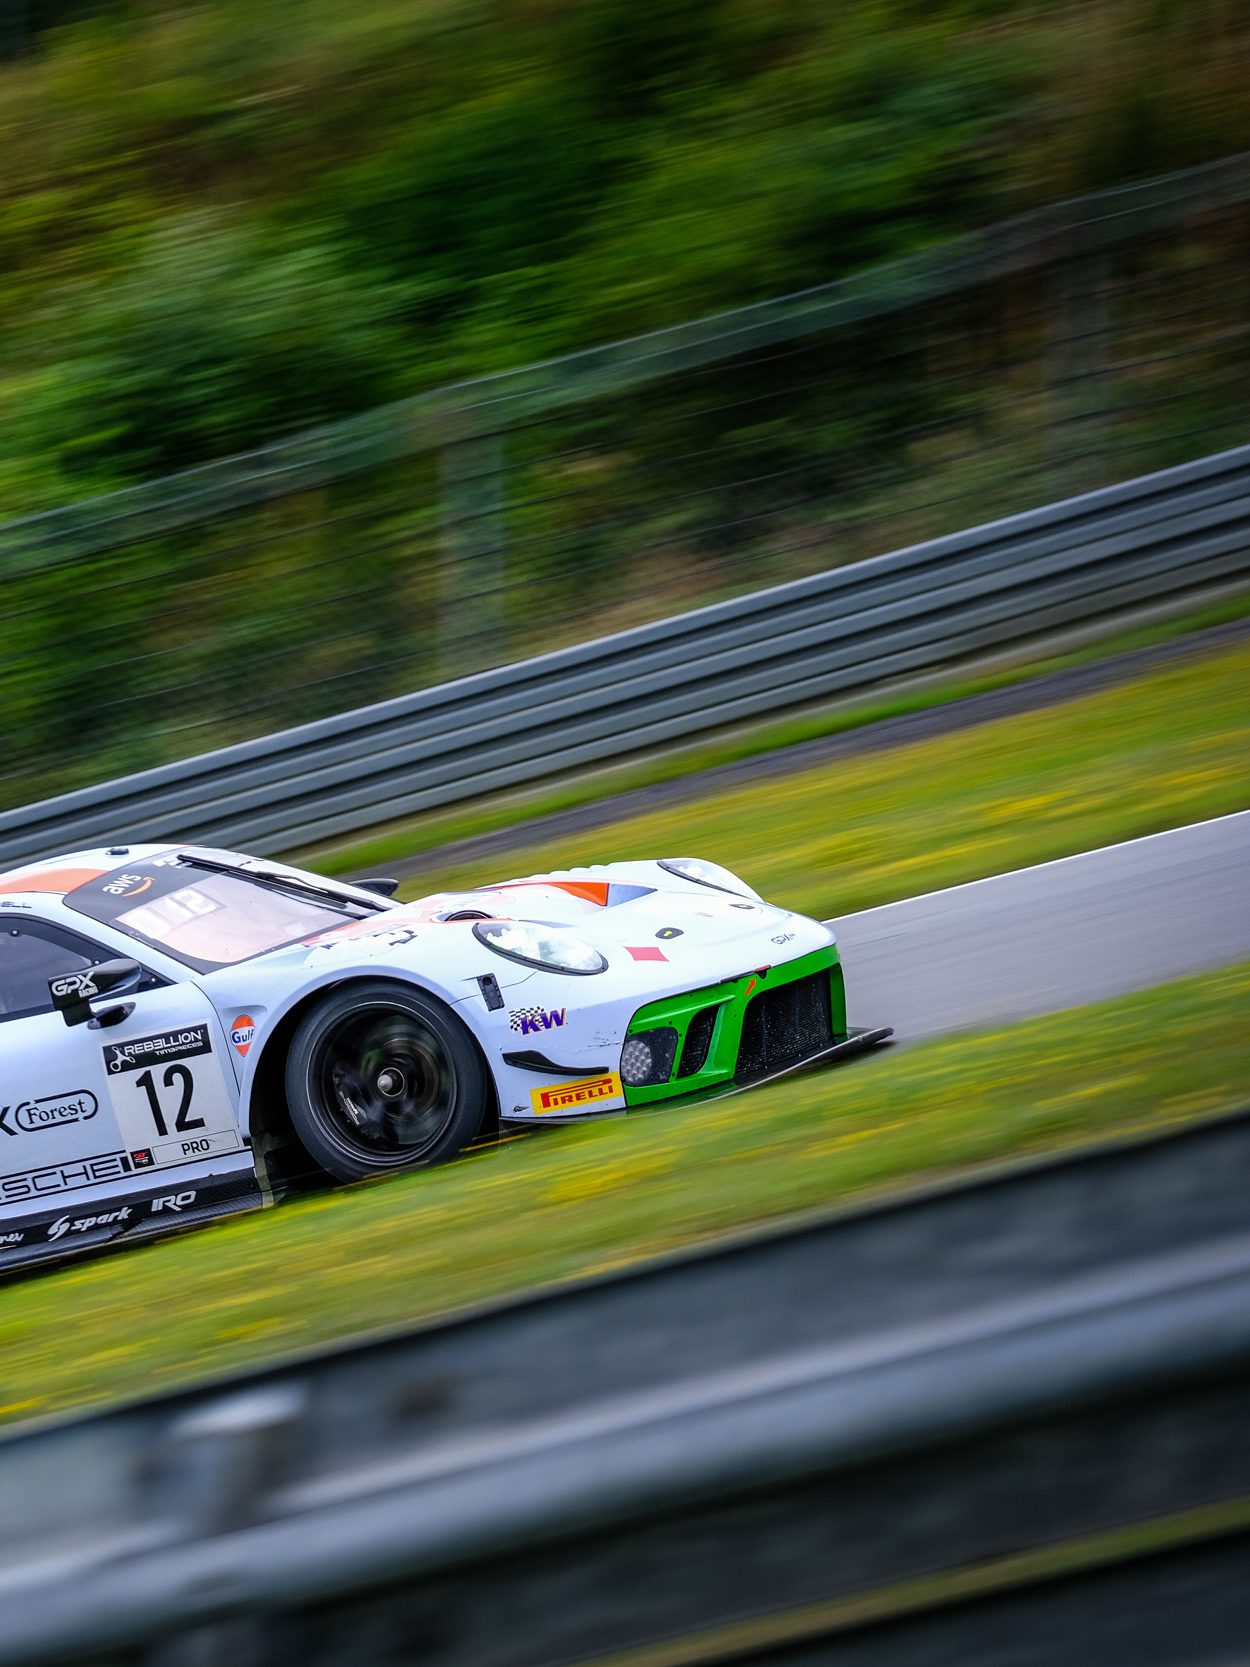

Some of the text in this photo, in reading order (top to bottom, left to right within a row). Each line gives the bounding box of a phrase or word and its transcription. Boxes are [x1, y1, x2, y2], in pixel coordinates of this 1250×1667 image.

[102, 874, 142, 895] aws
[51, 971, 95, 996] GPX
[78, 985, 99, 998] RACING
[519, 1006, 567, 1036] KW
[124, 1030, 203, 1056] REBELLION
[231, 1028, 255, 1044] Gulf
[135, 1063, 206, 1137] 12
[540, 1078, 614, 1109] PIRELLI
[24, 1098, 88, 1125] Forest
[181, 1138, 210, 1156] PRO
[151, 1190, 197, 1212] IRO
[70, 1206, 134, 1232] spark
